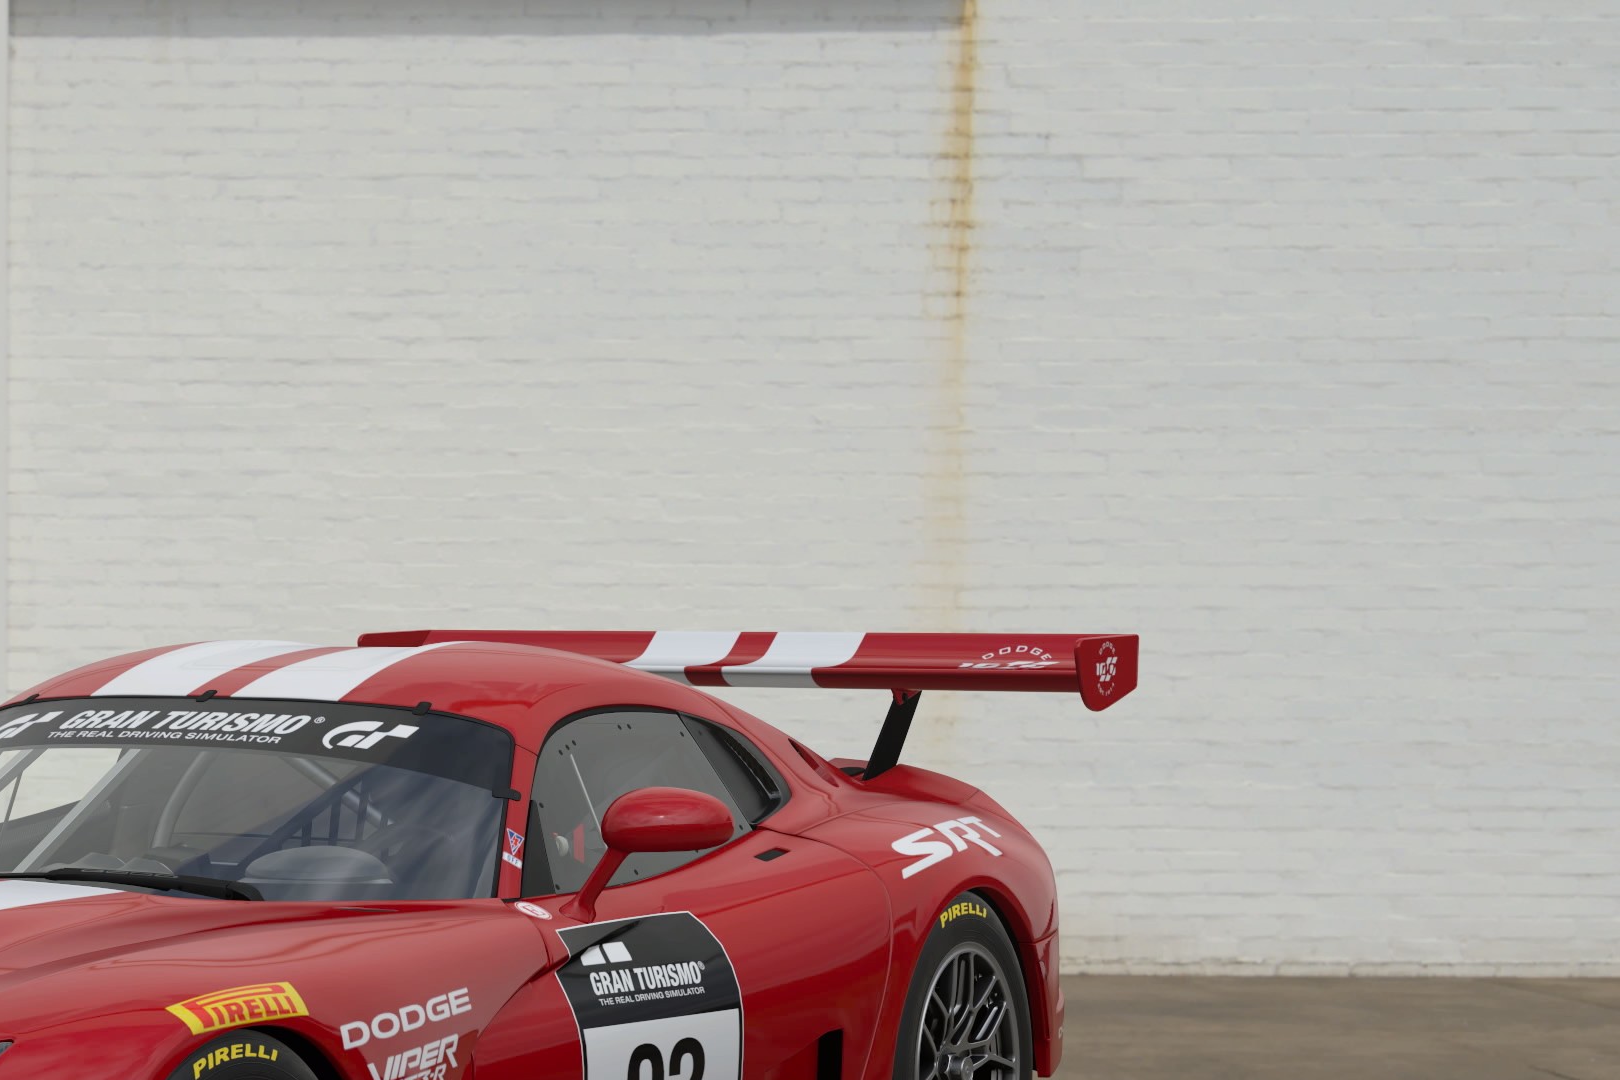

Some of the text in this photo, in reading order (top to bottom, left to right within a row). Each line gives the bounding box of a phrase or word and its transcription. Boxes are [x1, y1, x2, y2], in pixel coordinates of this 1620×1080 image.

[59, 710, 161, 730] GRAN
[47, 731, 77, 739] THE
[118, 731, 183, 740] DRIVING
[184, 732, 282, 744] SIMULATOR
[891, 815, 1003, 879] SRT
[940, 902, 987, 928] PIRELLI
[589, 969, 635, 995] GRAN
[181, 985, 298, 1029] PIRELLI
[598, 986, 706, 1006] THE REAL DRIVING SIMULATOR
[340, 987, 472, 1050] DODGE
[193, 1043, 278, 1080] PIRELLI
